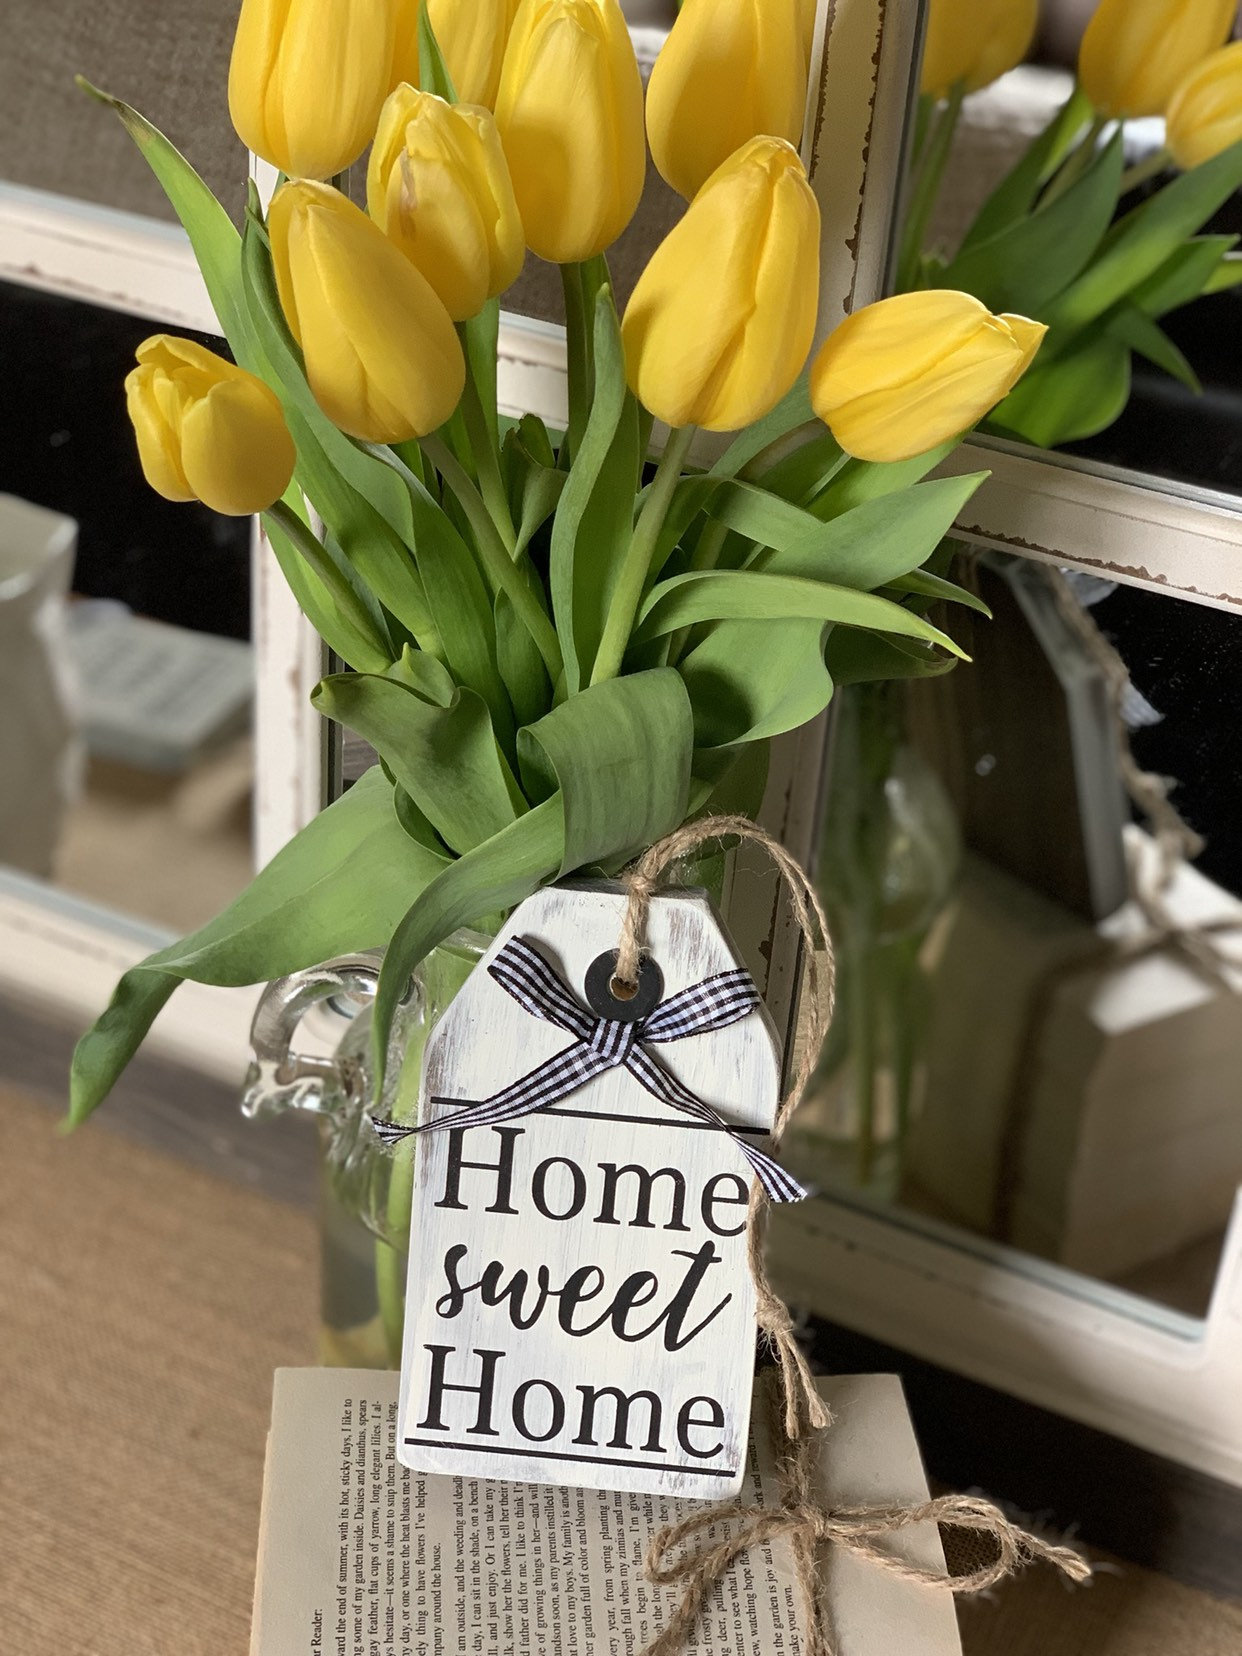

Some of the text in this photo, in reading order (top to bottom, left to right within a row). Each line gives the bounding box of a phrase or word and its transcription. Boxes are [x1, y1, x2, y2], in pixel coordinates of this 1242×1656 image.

[434, 1126, 749, 1237] Home
[436, 1240, 732, 1352] sweet
[386, 1400, 399, 1424] long,
[417, 1344, 725, 1459] Home
[370, 1423, 381, 1446] lilies.
[388, 1432, 396, 1443] on
[370, 1449, 383, 1481] elegant
[385, 1445, 396, 1460] But
[385, 1463, 395, 1487] them.
[750, 1474, 762, 1489] and
[369, 1484, 383, 1503] long
[384, 1488, 398, 1507] snip
[415, 1480, 428, 1509] helped
[336, 1398, 354, 1633] the end of summer, with its hot, sticky days, like to
[352, 1399, 369, 1643] some of my garden inside. Daisies and dianthus, spears
[372, 1507, 382, 1539] yarrow,
[386, 1509, 395, 1518] to
[543, 1495, 555, 1530] instilled
[642, 1501, 653, 1524] while
[658, 1503, 671, 1522] they
[369, 1542, 379, 1553] of
[384, 1520, 395, 1548] shame
[547, 1531, 560, 1563] parents
[399, 1481, 413, 1644] day, or one where the heat blasts me
[415, 1534, 426, 1565] flowers
[498, 1485, 514, 1639] show her the flowers, tell her their
[531, 1546, 542, 1555] in
[371, 1556, 382, 1577] cups
[387, 1558, 395, 1586] seems
[453, 1501, 467, 1651] am outside, and the weeding and
[468, 1481, 485, 1652] day, can sit in the shade, on bench
[484, 1487, 500, 1641] and just enjoy. Or can take my
[513, 1496, 530, 1647] father did for me. like to think
[532, 1558, 545, 1586] things
[550, 1565, 560, 1580] my
[560, 1510, 578, 1646] love to my boys. My family is
[575, 1499, 595, 1638] garden full of color and bloom
[598, 1505, 619, 1631] year, from spring planting
[612, 1509, 632, 1625] fall when my zinnias and
[368, 1580, 379, 1595] flat
[415, 1569, 426, 1591] have
[431, 1542, 442, 1623] around the house.
[551, 1582, 559, 1592] as
[727, 1577, 738, 1600] what
[417, 1595, 426, 1605] to
[533, 1589, 548, 1629] growing
[552, 1594, 561, 1620] soon,
[634, 1587, 648, 1614] begin
[711, 1579, 728, 1642] deer, pulling
[732, 1602, 741, 1617] see
[743, 1568, 758, 1637] watching hope
[761, 1548, 784, 1648] the garden is joy and
[785, 1584, 800, 1632] your own.
[368, 1598, 380, 1635] feather,
[415, 1610, 429, 1635] thing
[652, 1605, 663, 1620] the
[734, 1619, 742, 1630] to
[311, 1609, 323, 1647] Reader:
[534, 1631, 546, 1644] of
[699, 1616, 713, 1645] frosty
